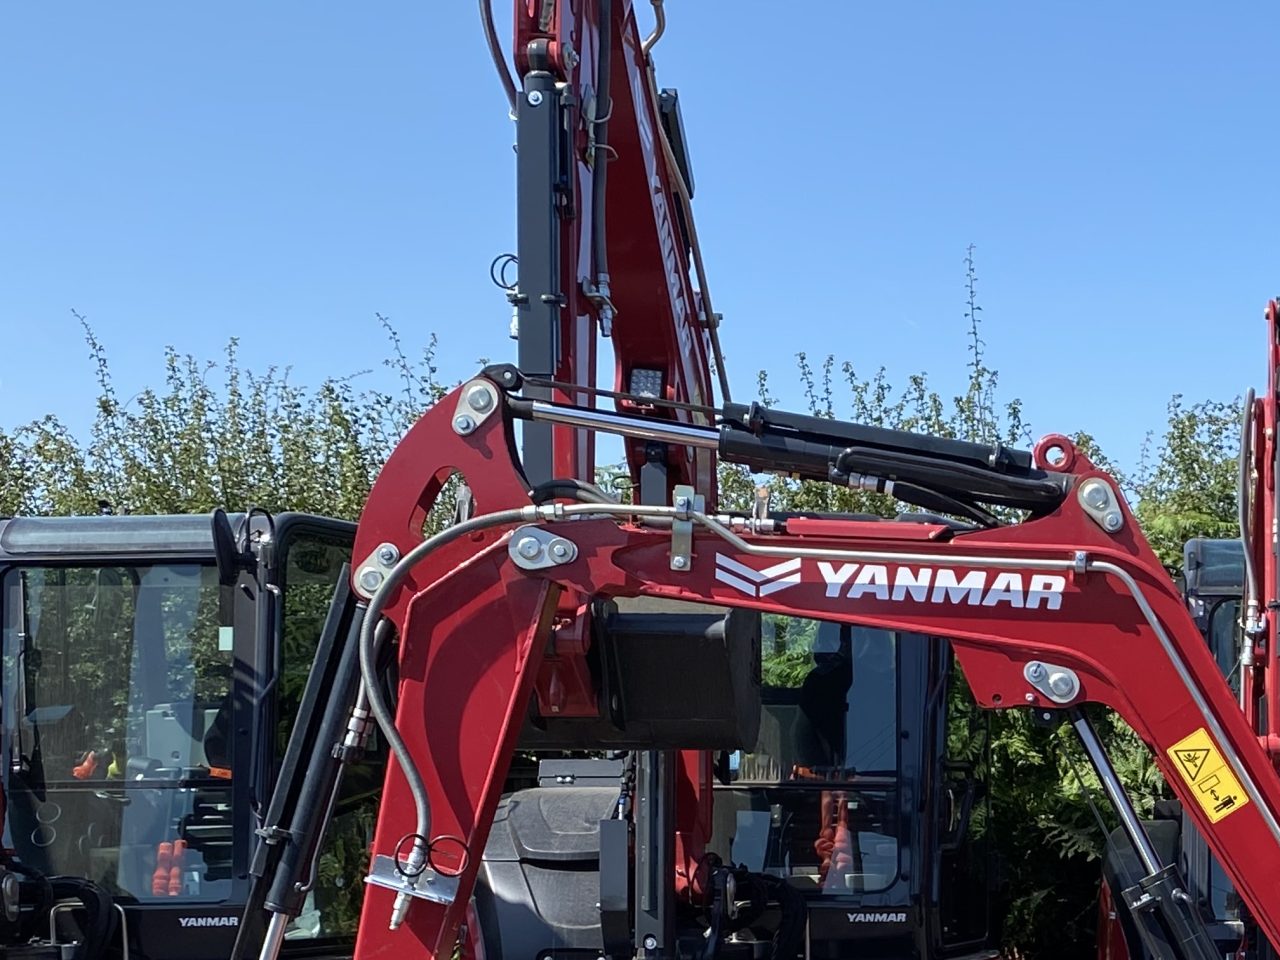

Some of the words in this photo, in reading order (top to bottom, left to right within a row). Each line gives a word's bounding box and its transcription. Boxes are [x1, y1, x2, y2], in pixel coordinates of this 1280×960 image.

[817, 561, 1066, 610] YANMAR
[178, 916, 239, 927] YANMAR
[847, 912, 907, 922] YANMAR
